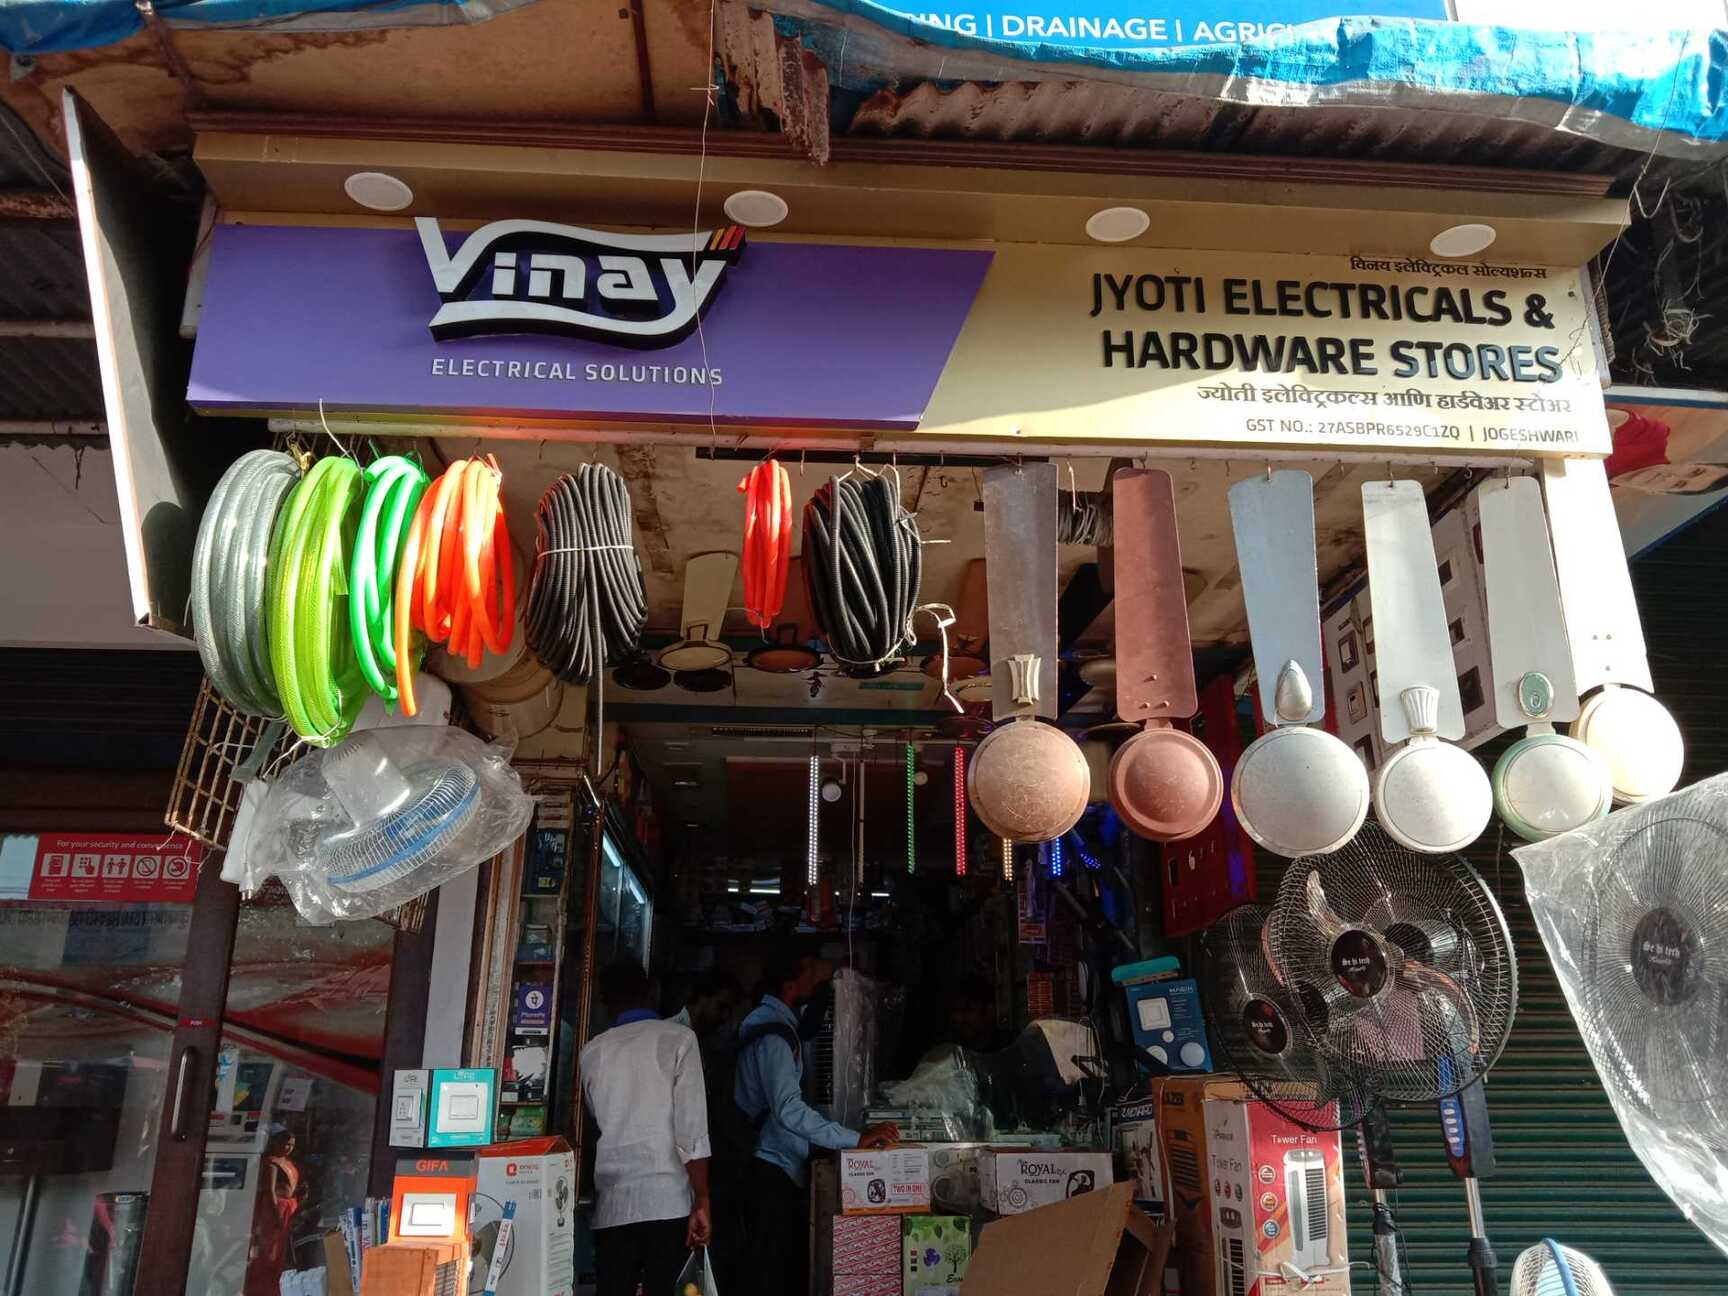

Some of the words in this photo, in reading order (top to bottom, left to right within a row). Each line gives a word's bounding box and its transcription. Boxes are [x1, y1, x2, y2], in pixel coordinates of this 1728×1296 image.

[1001, 15, 1168, 41] DRAINAGE
[414, 216, 730, 337] Vinay
[1350, 256, 1391, 273] विनय
[1090, 273, 1206, 318] JYOTI
[1223, 278, 1512, 327] ELECTRICALS
[1523, 293, 1556, 330] &
[1102, 330, 1378, 377] HARDWARE
[1391, 340, 1564, 384] STORES
[431, 358, 577, 381] ELECTRICAL
[585, 363, 724, 386] SOLUTIONS
[1197, 382, 1257, 402] ज्योती
[1383, 388, 1432, 408] आणि
[1246, 418, 1275, 433] GST
[1280, 420, 1313, 434] NO.:
[1483, 426, 1579, 444] JOGESHWARI
[1271, 1134, 1298, 1145] Tower
[1299, 1135, 1317, 1145] Fan
[416, 1159, 449, 1172] GIFA
[847, 1160, 874, 1170] ROYAL
[1021, 1163, 1057, 1176] ROYAL
